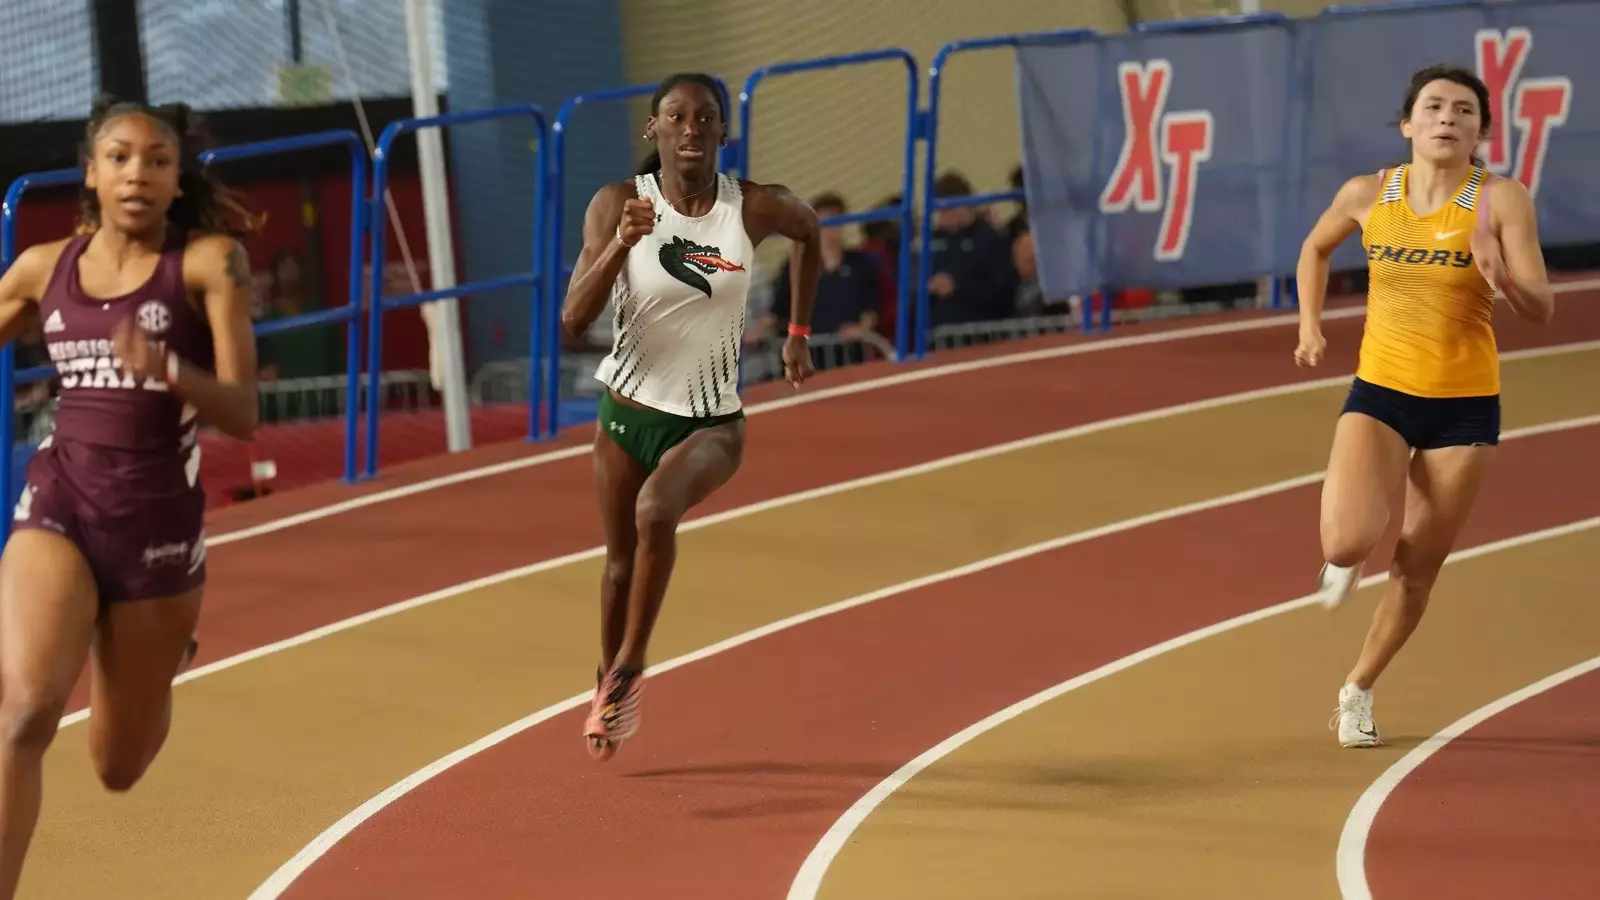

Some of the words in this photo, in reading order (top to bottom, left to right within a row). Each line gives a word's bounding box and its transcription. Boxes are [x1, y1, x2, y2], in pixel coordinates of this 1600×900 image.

[1099, 59, 1214, 262] XT
[1475, 28, 1573, 200] XT
[1369, 244, 1473, 268] EMORY
[138, 301, 169, 331] SEC
